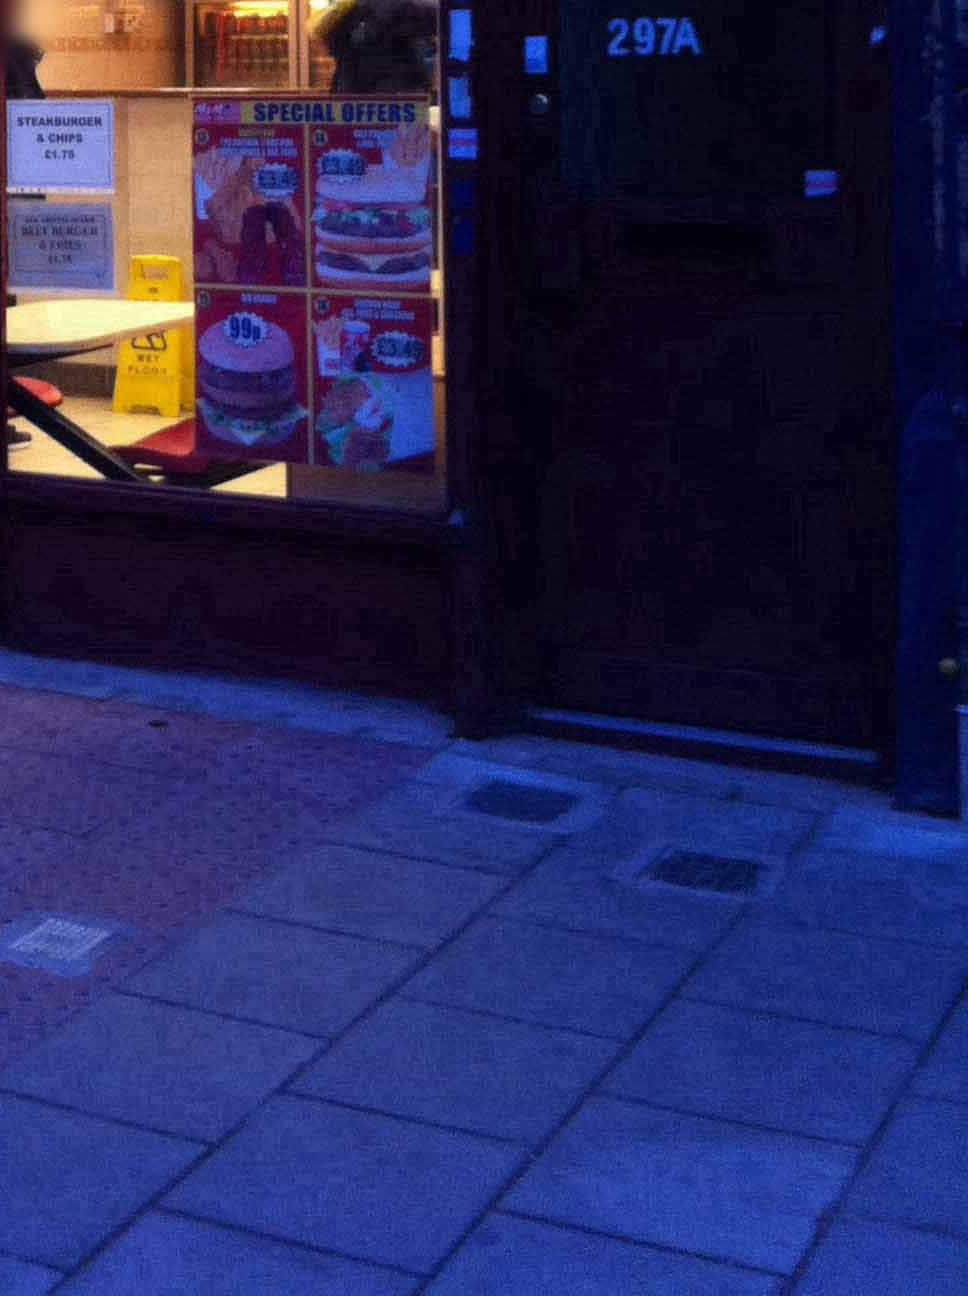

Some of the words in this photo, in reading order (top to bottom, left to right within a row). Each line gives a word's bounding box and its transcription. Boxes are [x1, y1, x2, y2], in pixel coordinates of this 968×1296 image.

[607, 18, 701, 55] 297A
[16, 115, 103, 127] STEAKBURGER
[253, 104, 336, 122] SPECIAL
[341, 104, 416, 123] OFFERS
[36, 133, 45, 143] &
[48, 133, 83, 144] CHIPS
[230, 316, 261, 342] 99p
